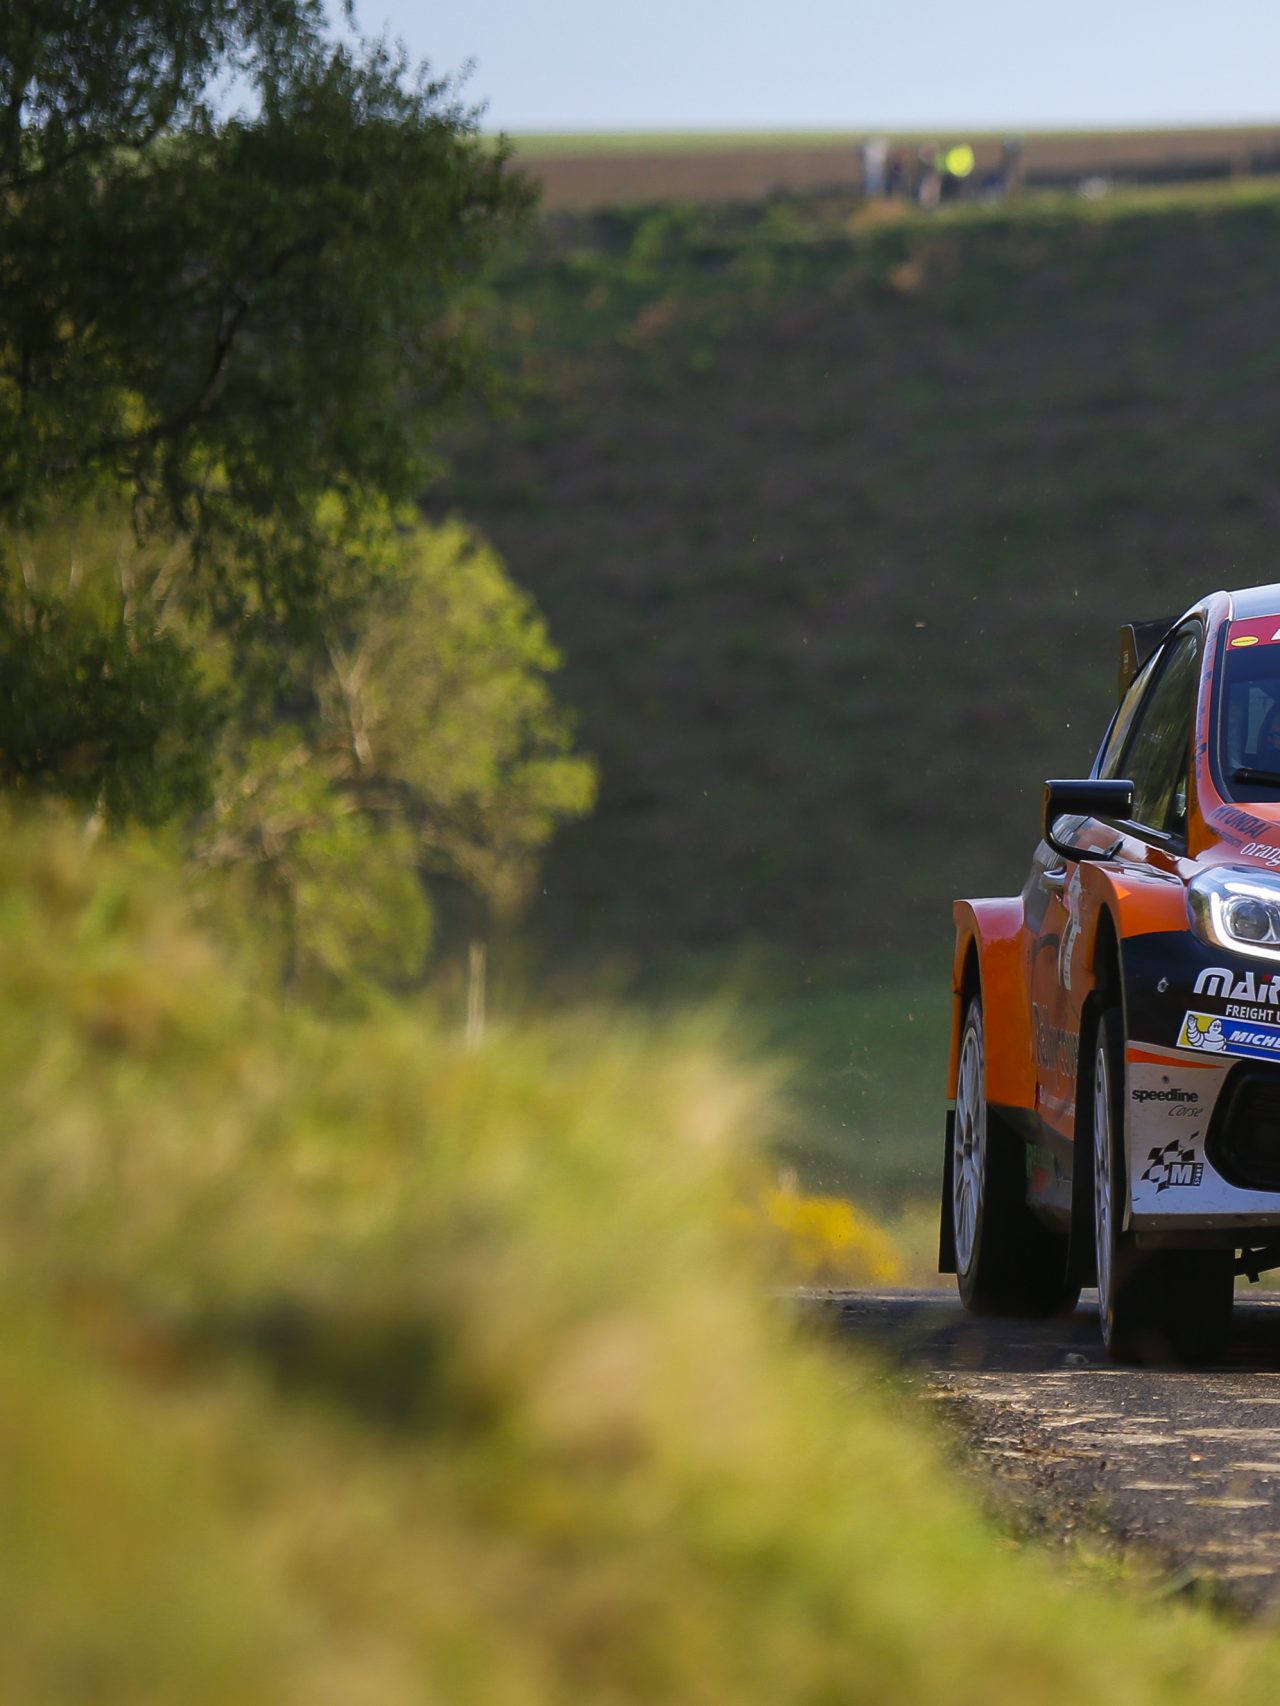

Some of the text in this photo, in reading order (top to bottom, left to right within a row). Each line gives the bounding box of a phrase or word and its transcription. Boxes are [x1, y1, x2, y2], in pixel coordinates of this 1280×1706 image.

[1225, 1004, 1273, 1021] FREIGHT
[1132, 1088, 1199, 1103] speedline
[1168, 1104, 1204, 1118] Corse
